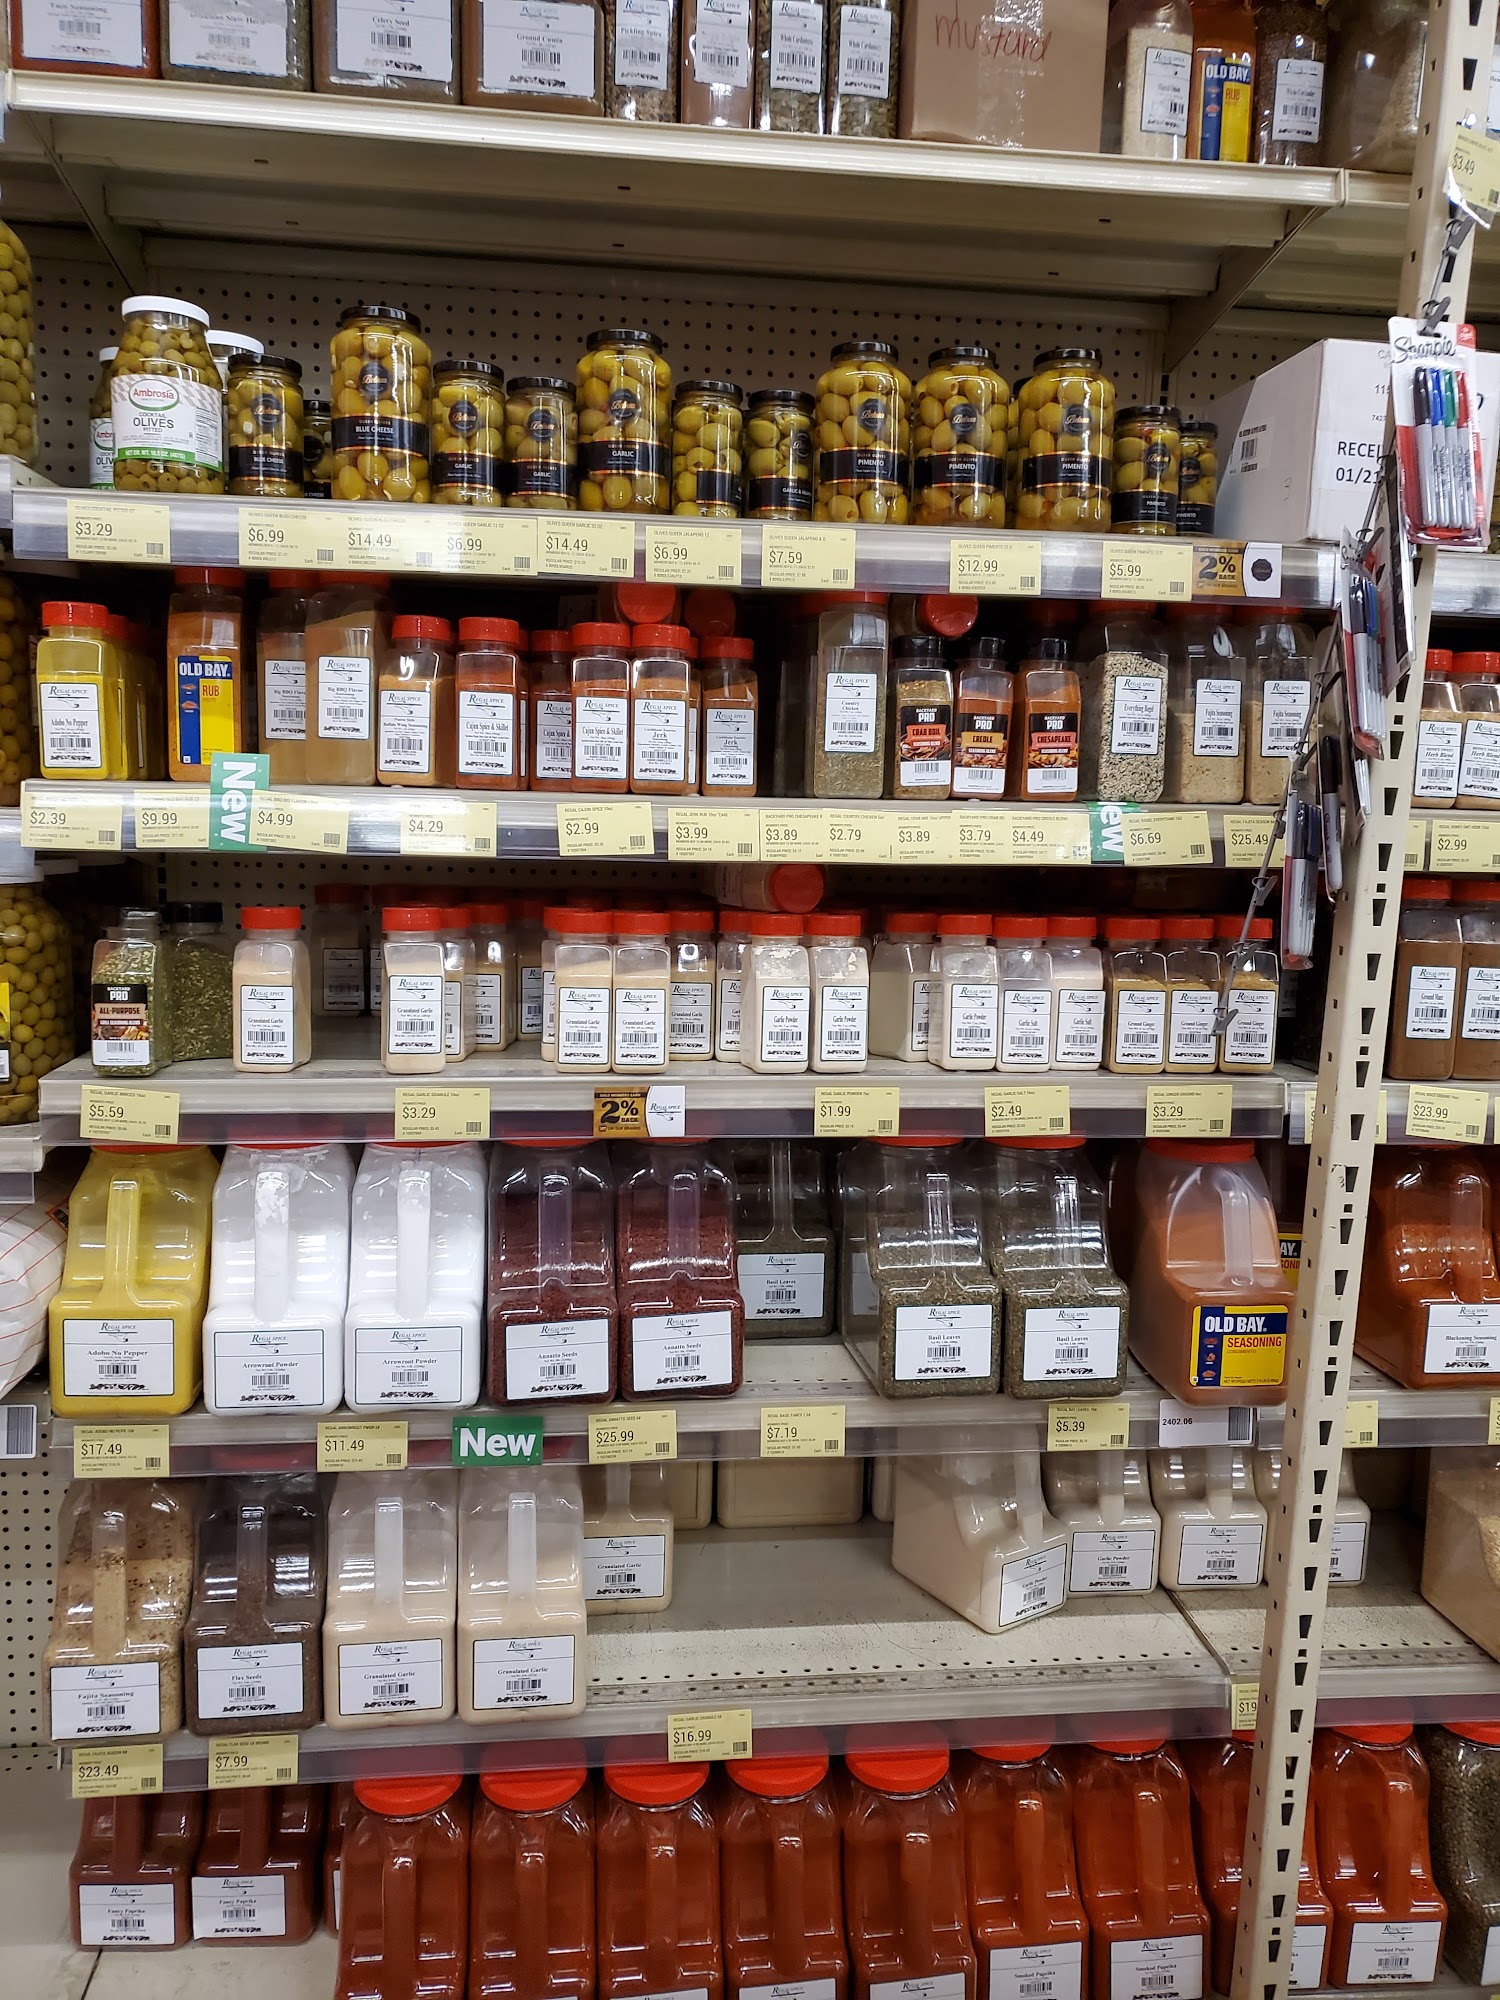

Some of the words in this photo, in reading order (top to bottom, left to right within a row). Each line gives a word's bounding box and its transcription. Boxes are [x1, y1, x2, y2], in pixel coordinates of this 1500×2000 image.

[394, 18, 410, 26] Seed
[1206, 64, 1228, 79] OLD
[1230, 66, 1248, 81] BAY
[1226, 89, 1240, 99] RUB
[1452, 153, 1475, 175] $3.49
[1392, 336, 1456, 364] Sharpie
[133, 418, 174, 429] OLIVES
[355, 426, 369, 434] BLUE
[371, 426, 394, 435] CHEESE
[858, 459, 884, 467] PIMENTO
[75, 521, 113, 537] $3.29
[248, 529, 284, 544] $6.99
[348, 532, 392, 547] $14.49
[447, 537, 482, 552] $6.99
[546, 537, 588, 552] $14.49
[654, 546, 688, 561] $6.99
[769, 550, 803, 565] $7.59
[958, 559, 998, 572] $12.99
[1110, 563, 1141, 577] $5.99
[1199, 555, 1236, 580] 2%
[179, 662, 203, 677] OLD
[205, 663, 228, 677] BAY
[202, 685, 220, 697] RUB
[51, 718, 64, 727] Adobo
[65, 718, 73, 727] No
[74, 719, 89, 729] Pepper
[918, 712, 935, 722] PRO
[466, 722, 478, 731] Cajun
[479, 722, 490, 731] Spice
[975, 719, 992, 730] PRO
[1046, 719, 1063, 730] PRO
[652, 731, 667, 739] Jerk
[912, 728, 925, 736] CRAB
[926, 728, 941, 736] BOIL
[1037, 735, 1072, 744] CHESAPEAKE
[221, 761, 257, 844] New
[30, 811, 66, 826] $2.39
[141, 812, 177, 826] $9.99
[257, 811, 293, 826] $4.99
[408, 820, 443, 834] $4.29
[566, 822, 599, 836] $2.99
[676, 826, 708, 840] $3.99
[1097, 802, 1124, 853] ew
[765, 829, 798, 841] $3.89
[829, 828, 861, 841] $2.79
[898, 830, 930, 843] $3.89
[959, 829, 991, 842] $3.79
[1012, 830, 1044, 843] $4.49
[1130, 832, 1161, 846] $6.69
[1231, 832, 1268, 846] $25.49
[1437, 838, 1467, 851] $2.99
[109, 991, 128, 1001] PRO
[99, 1007, 140, 1015] ALL-PURPOSE
[89, 1104, 124, 1118] $5.59
[402, 1106, 436, 1119] $3.29
[600, 1100, 639, 1124] 2%
[820, 1105, 851, 1117] $1.99
[991, 1105, 1022, 1117] $2.49
[1153, 1105, 1183, 1117] $3.29
[1413, 1105, 1449, 1119] $23.99
[1204, 1315, 1234, 1333] OLD
[1237, 1316, 1263, 1333] BAY
[1227, 1336, 1282, 1348] SEASONING
[123, 1350, 148, 1358] Pepper
[1056, 1420, 1085, 1433] $5.39
[1162, 1417, 1193, 1426] 2402.06
[596, 1430, 634, 1445] $25.99
[767, 1427, 797, 1439] $7.19
[325, 1439, 364, 1452] $11.49
[460, 1427, 536, 1457] New
[81, 1443, 122, 1457] $17.49
[673, 1730, 711, 1744] $16.99
[215, 1756, 248, 1769] $7.99
[78, 1765, 119, 1779] $23.49
